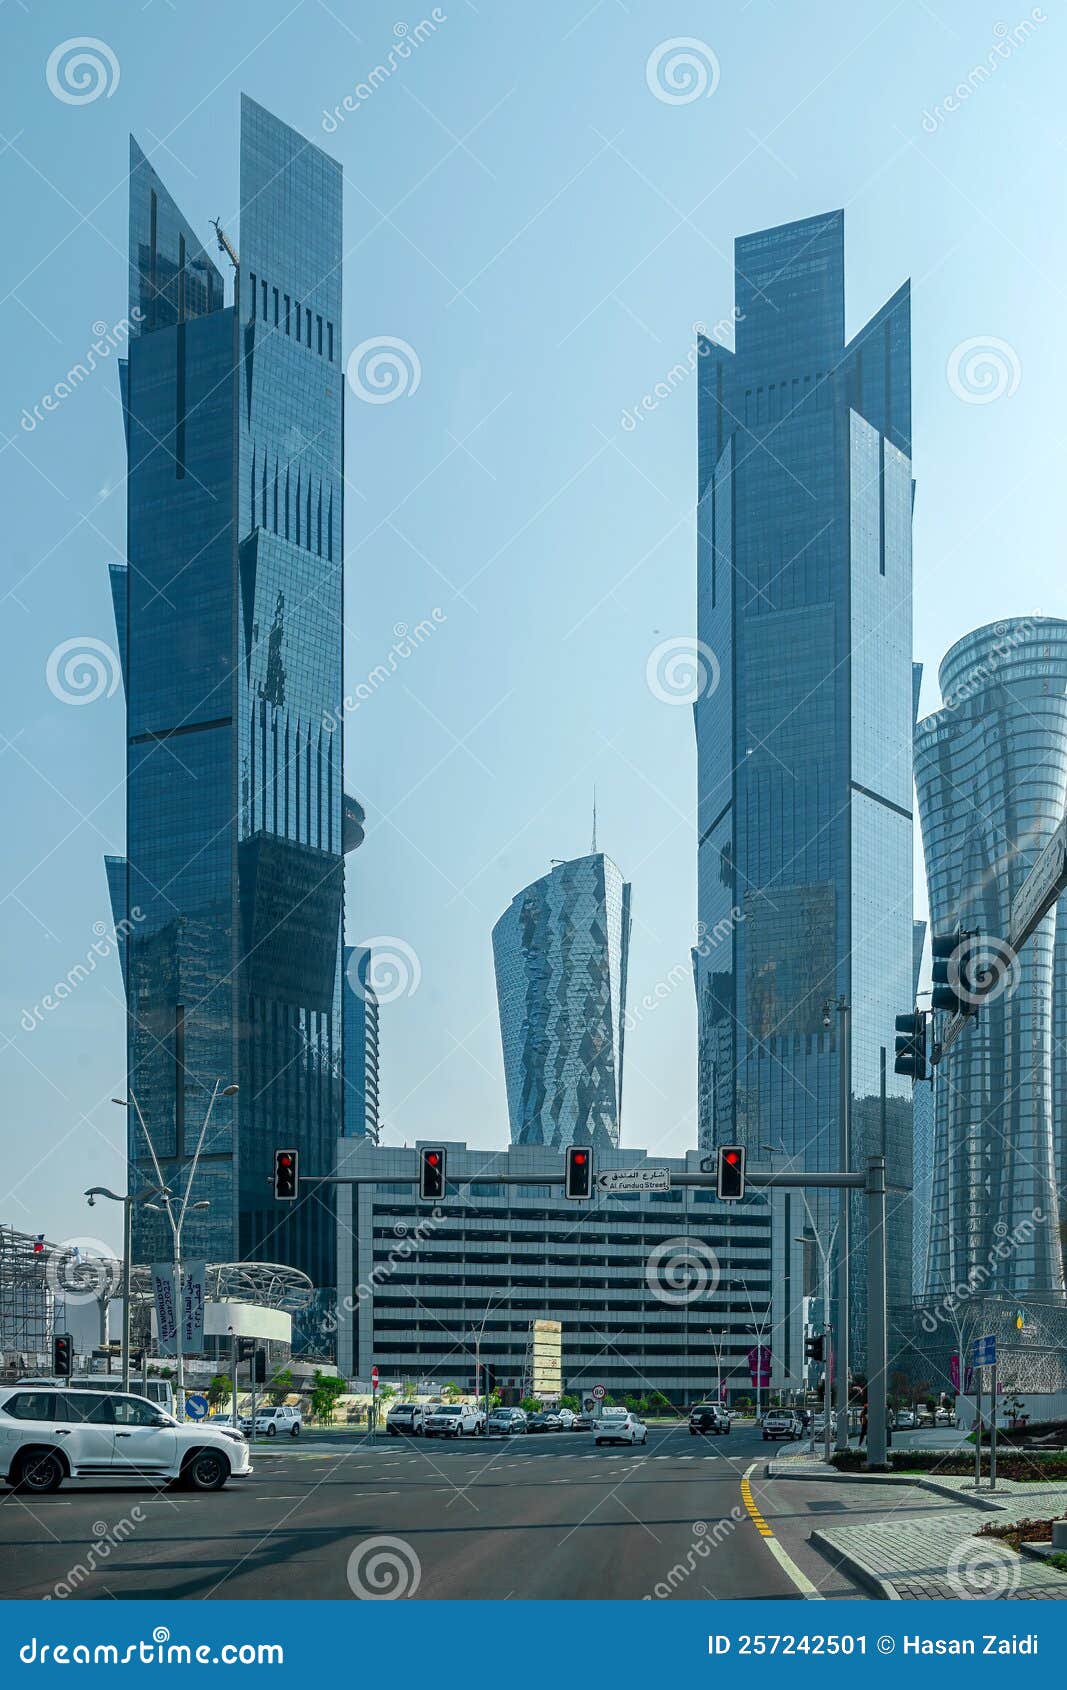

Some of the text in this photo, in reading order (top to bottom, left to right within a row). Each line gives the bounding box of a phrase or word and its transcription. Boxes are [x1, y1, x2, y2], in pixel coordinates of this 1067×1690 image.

[645, 1180, 667, 1189] Street
[155, 1276, 163, 1293] CUP
[158, 1294, 167, 1323] WORLD
[163, 1280, 177, 1338] Qatar 2022
